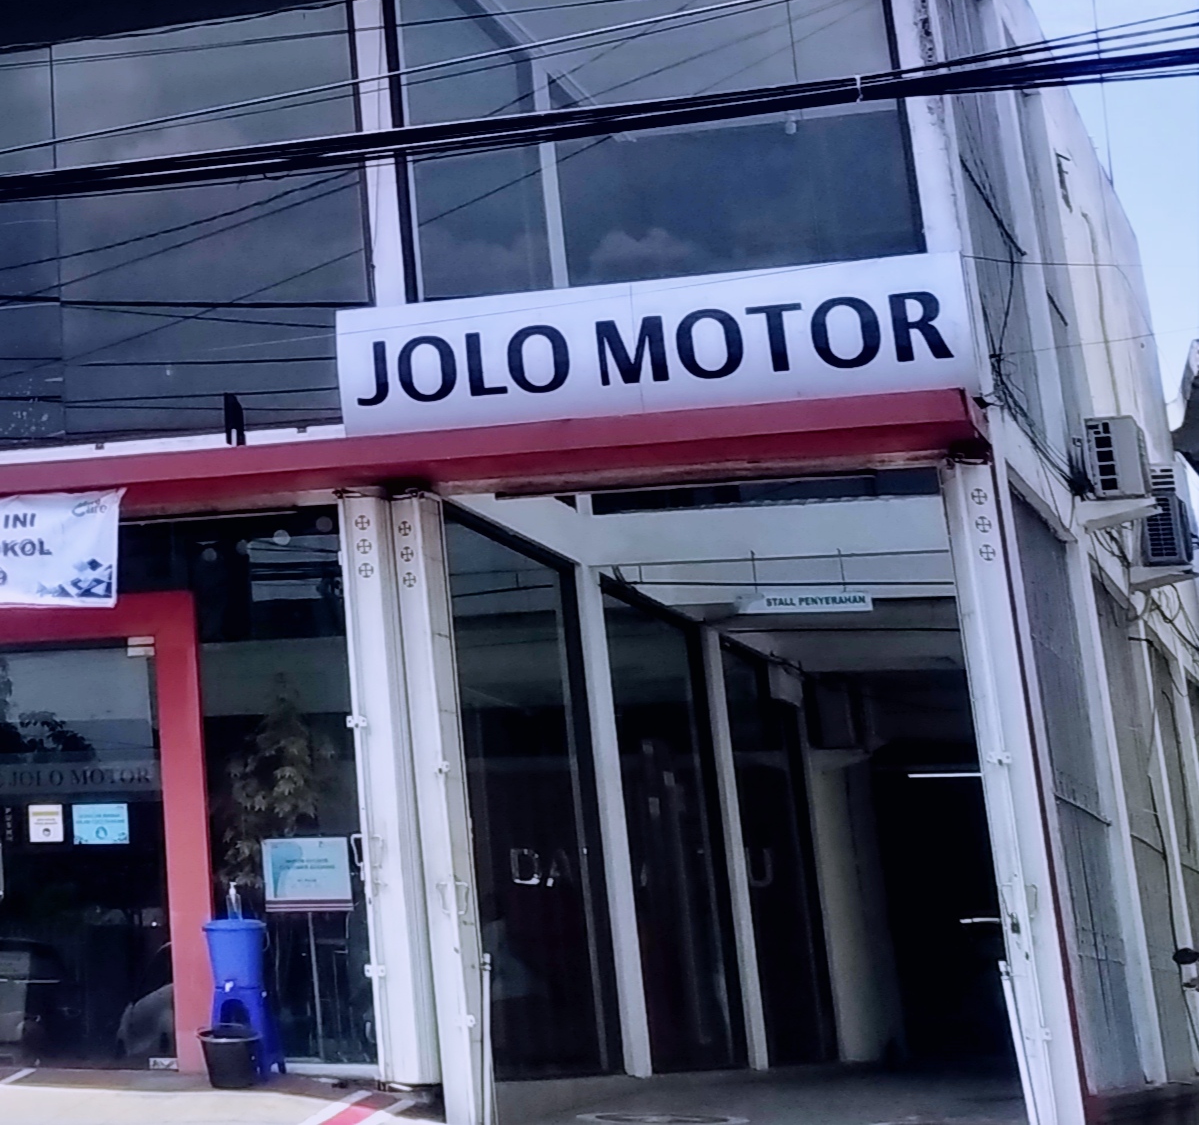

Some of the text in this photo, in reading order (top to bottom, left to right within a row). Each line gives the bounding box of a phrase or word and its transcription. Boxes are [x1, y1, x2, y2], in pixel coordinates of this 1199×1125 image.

[357, 291, 955, 406] JOLO MOTOR
[3, 513, 37, 529] INI
[766, 595, 867, 607] STALL PENYERAHAN
[70, 768, 151, 786] MOTOR
